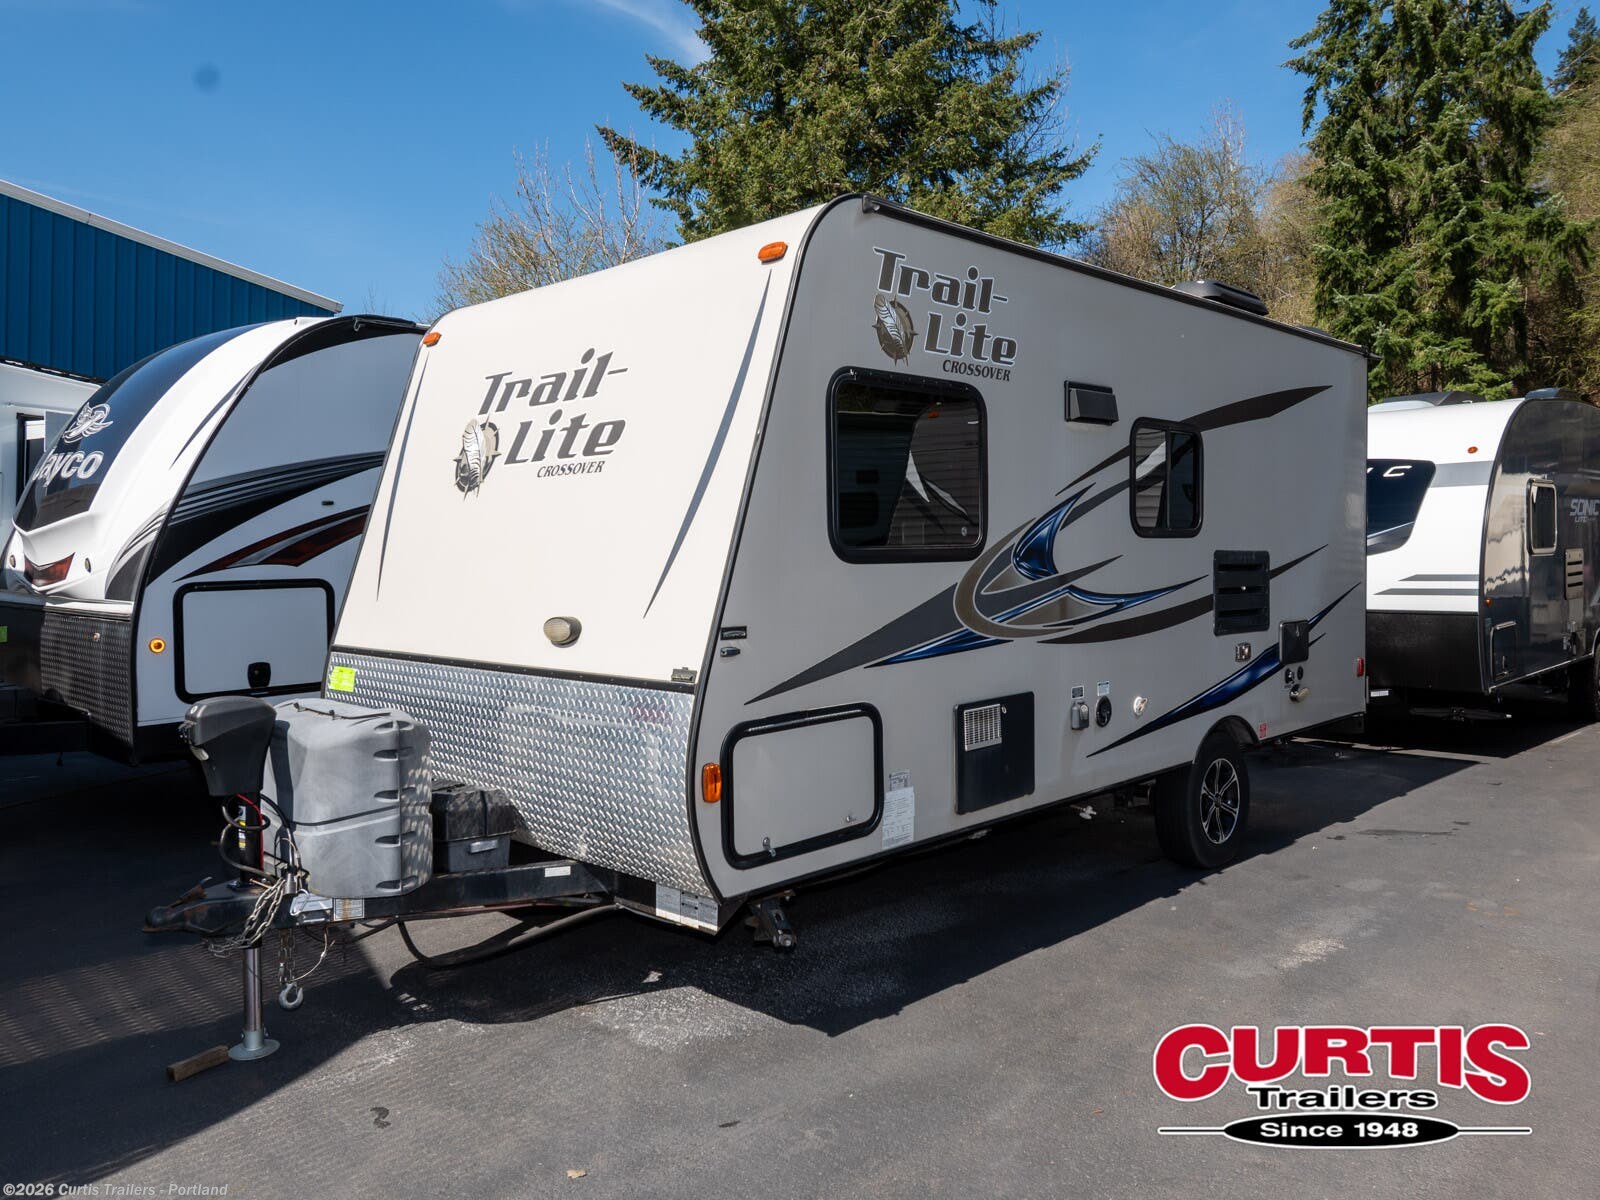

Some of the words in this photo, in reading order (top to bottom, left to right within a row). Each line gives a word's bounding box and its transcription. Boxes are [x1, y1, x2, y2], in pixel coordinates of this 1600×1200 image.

[873, 246, 1008, 314] Trail-
[924, 312, 1017, 366] Lite
[478, 347, 629, 416] Trail-
[942, 359, 1011, 382] CROSSOVER
[504, 408, 626, 465] Lite
[536, 460, 606, 478] CROSSOVER
